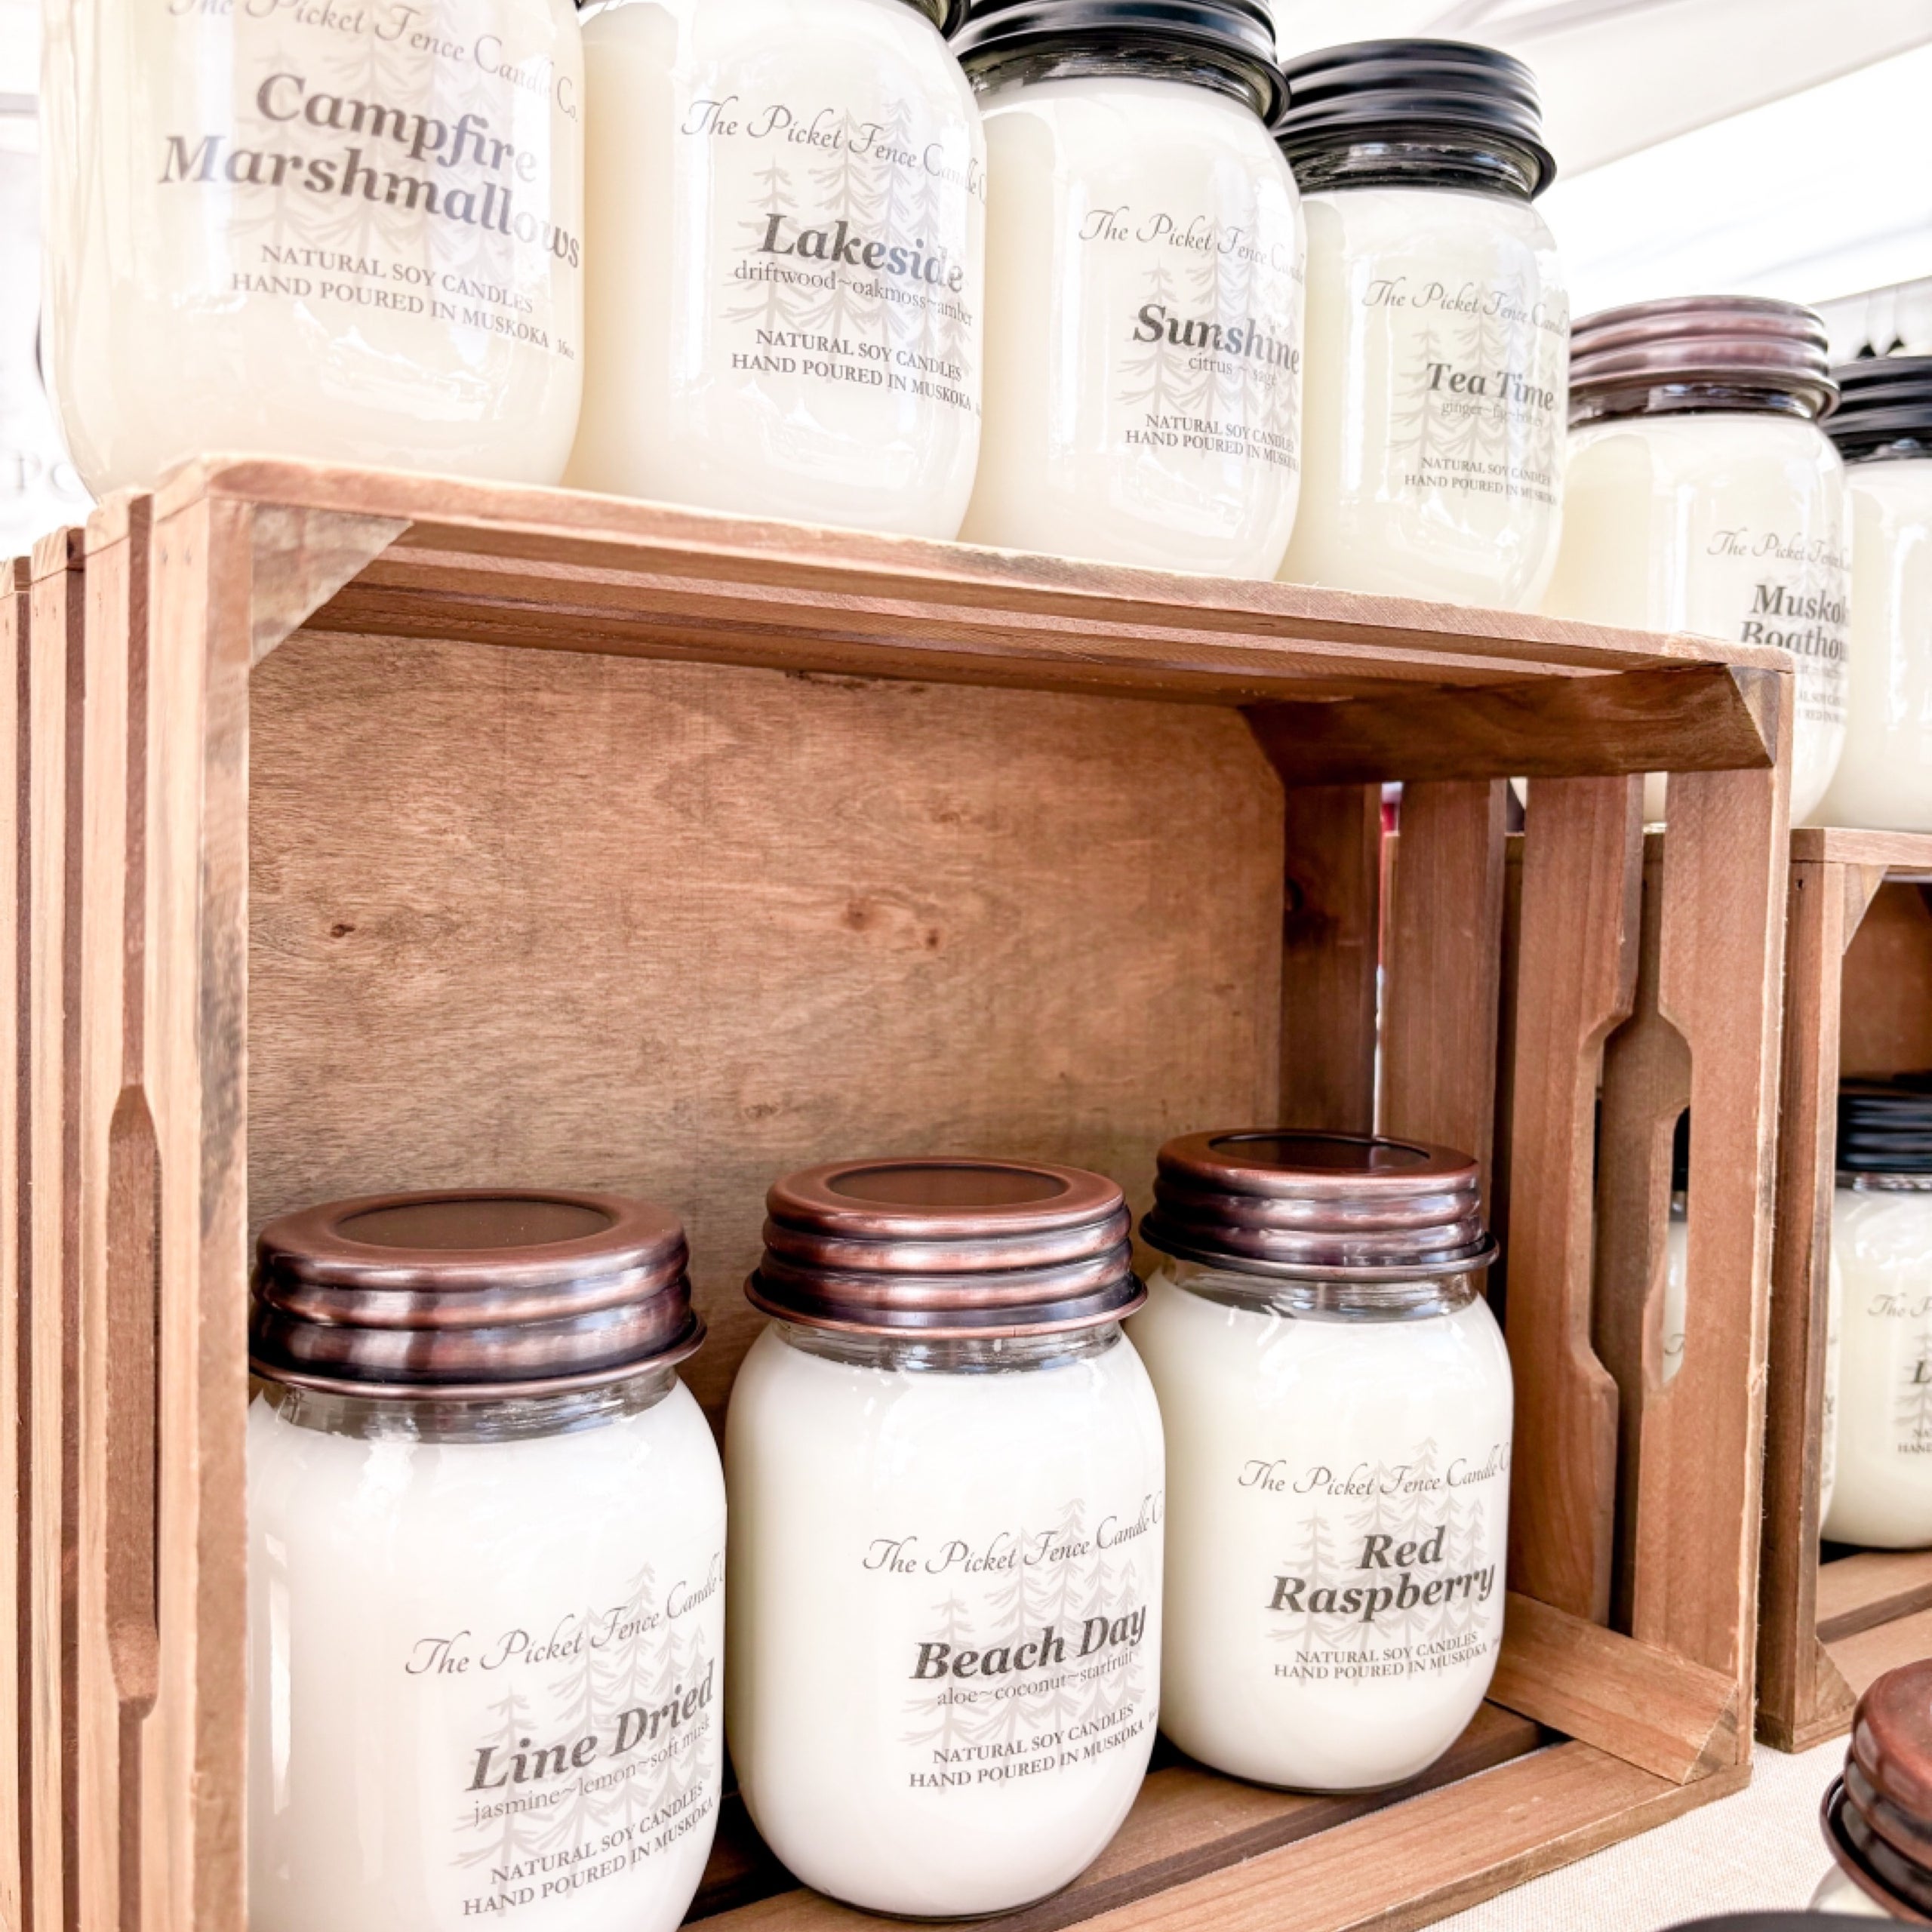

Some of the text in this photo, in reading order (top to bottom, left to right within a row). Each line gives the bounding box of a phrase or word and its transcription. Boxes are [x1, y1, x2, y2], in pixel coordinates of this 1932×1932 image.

[374, 5, 465, 63] Fence
[556, 76, 578, 122] Co.
[256, 72, 537, 183] Campfire
[681, 96, 738, 137] The
[747, 104, 841, 149] Picket
[849, 123, 916, 168] Fence
[158, 135, 580, 269] Marshmallows
[757, 212, 964, 294] Lakeside
[1079, 206, 1129, 241] The
[1137, 214, 1212, 251] Picket
[1217, 226, 1266, 264] Fence
[260, 244, 533, 314] NATURAL SOY CANDLES
[1361, 276, 1406, 307] The
[1412, 281, 1480, 313] Picket
[232, 273, 312, 297] HAND
[319, 284, 425, 315] POURED
[430, 300, 457, 320] IN
[462, 309, 549, 348] MUSKOKA
[1133, 303, 1300, 374] Sunshine
[731, 352, 796, 374] HAND
[802, 359, 883, 386] POURED
[888, 371, 906, 392] IN
[912, 377, 971, 412] MUSKOKA
[756, 329, 962, 382] NATURAL SOY CANDLES
[1189, 352, 1233, 375] citrus
[1426, 362, 1554, 411] Tea Time
[1125, 430, 1178, 448] HAND
[1183, 435, 1244, 456] POURED
[1247, 441, 1260, 459] IN
[1146, 414, 1223, 435] NATURAL
[1226, 423, 1251, 440] SOY
[1404, 474, 1447, 488] HAND
[1452, 477, 1503, 495] POURED
[1506, 485, 1518, 496] IN
[1421, 457, 1484, 475] NATURAL
[1488, 463, 1509, 477] SOY
[1707, 527, 1748, 556] The
[1752, 532, 1805, 560] Picket
[1749, 584, 1849, 626] Musko
[1868, 1293, 1906, 1316] The
[1238, 1459, 1287, 1492] The
[1293, 1462, 1374, 1496] Picket
[1380, 1465, 1441, 1495] Fence
[1446, 1443, 1500, 1487] Candle
[863, 1536, 917, 1573] The
[924, 1532, 1016, 1574] Picket
[1023, 1531, 1090, 1566] Fence
[1096, 1494, 1152, 1549] Candle
[1355, 1524, 1446, 1570] Red
[405, 1630, 471, 1675] The
[480, 1613, 583, 1670] Picket
[591, 1605, 659, 1650] Fence
[666, 1552, 720, 1619] Candle
[1264, 1563, 1496, 1623] Raspberry
[909, 1604, 1148, 1680] Beach Day
[1274, 1664, 1328, 1679] HAND
[1334, 1663, 1404, 1679] POURED
[1408, 1659, 1426, 1673] IN
[1430, 1643, 1487, 1670] MUSKOKA
[1296, 1650, 1379, 1663] NATURAL
[1383, 1646, 1413, 1660] SOY
[1416, 1631, 1478, 1657] CANDLES
[465, 1657, 715, 1792] Line Dried
[682, 1712, 710, 1751] musk
[909, 1720, 1145, 1789] HAND POURED IN MUSKOKA
[932, 1739, 1028, 1765] NATURAL
[1032, 1730, 1065, 1750] SOY
[1068, 1703, 1134, 1741] CANDLES
[463, 1795, 715, 1916] HAND POURED IN MUSKOKA
[491, 1781, 704, 1884] NATURAL SOY CANDLES
